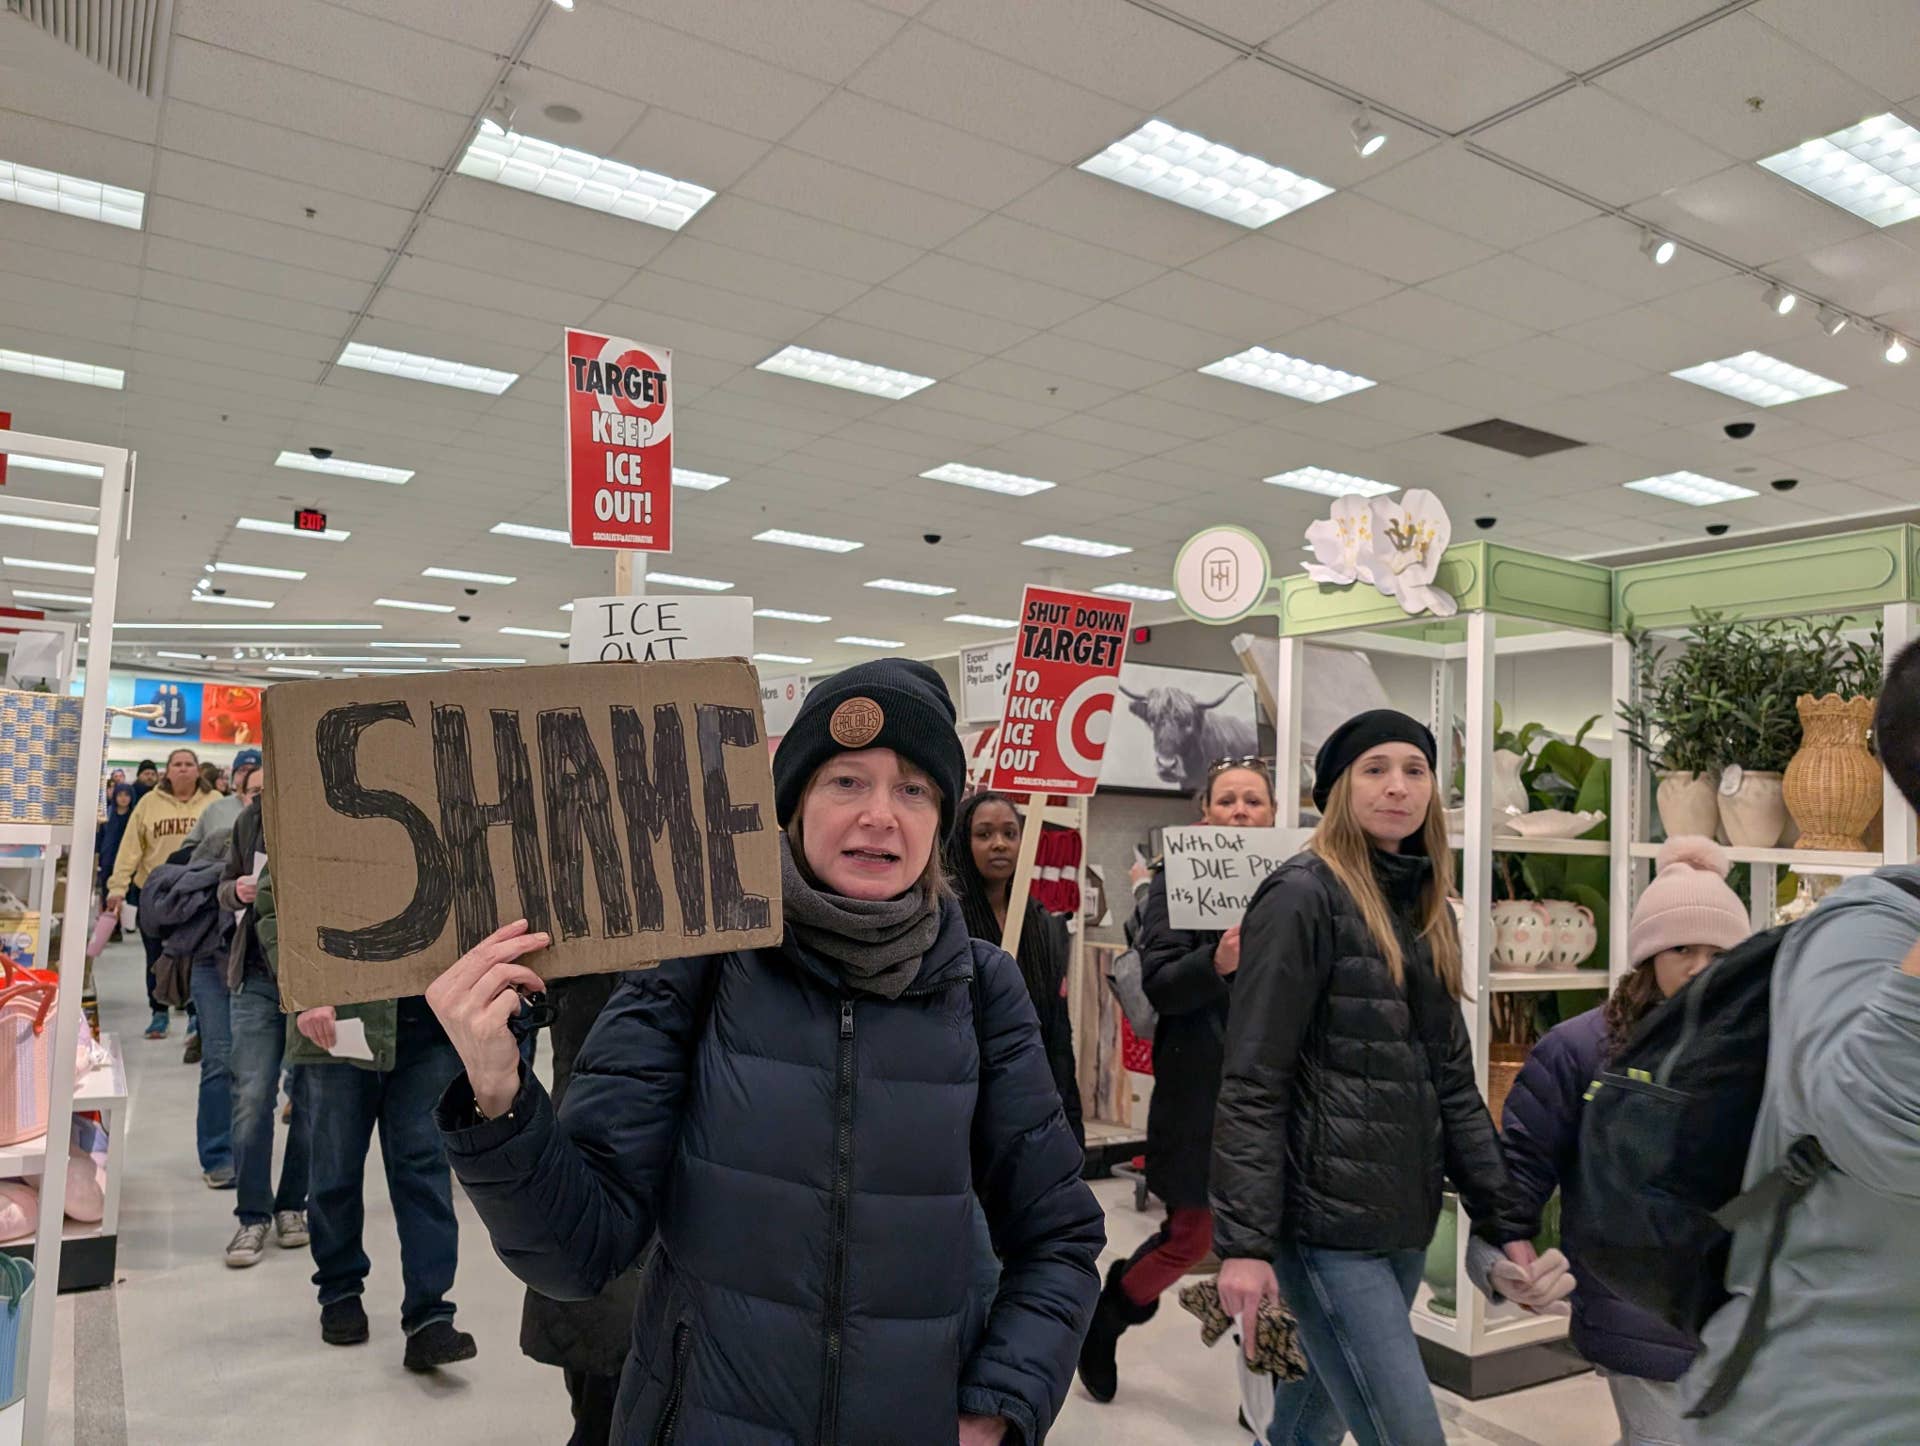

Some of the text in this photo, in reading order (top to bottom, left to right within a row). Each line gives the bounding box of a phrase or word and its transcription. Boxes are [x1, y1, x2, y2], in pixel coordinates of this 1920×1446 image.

[571, 356, 667, 404] TARGET
[591, 410, 653, 448] KEEP
[605, 450, 642, 486] ICE
[299, 511, 321, 530] EXIT
[593, 487, 652, 525] OUT!
[599, 602, 682, 638] ICE
[1027, 601, 1126, 633] SHUT DOWN
[1023, 624, 1123, 668] TARGET
[1015, 669, 1040, 694] TO
[1009, 695, 1055, 721] KICK
[1003, 721, 1035, 746] ICE
[998, 747, 1040, 772] OUT
[316, 700, 772, 962] SHAME
[1166, 832, 1246, 855] With Out
[1187, 857, 1240, 880] DUE
[1170, 887, 1193, 904] it's
